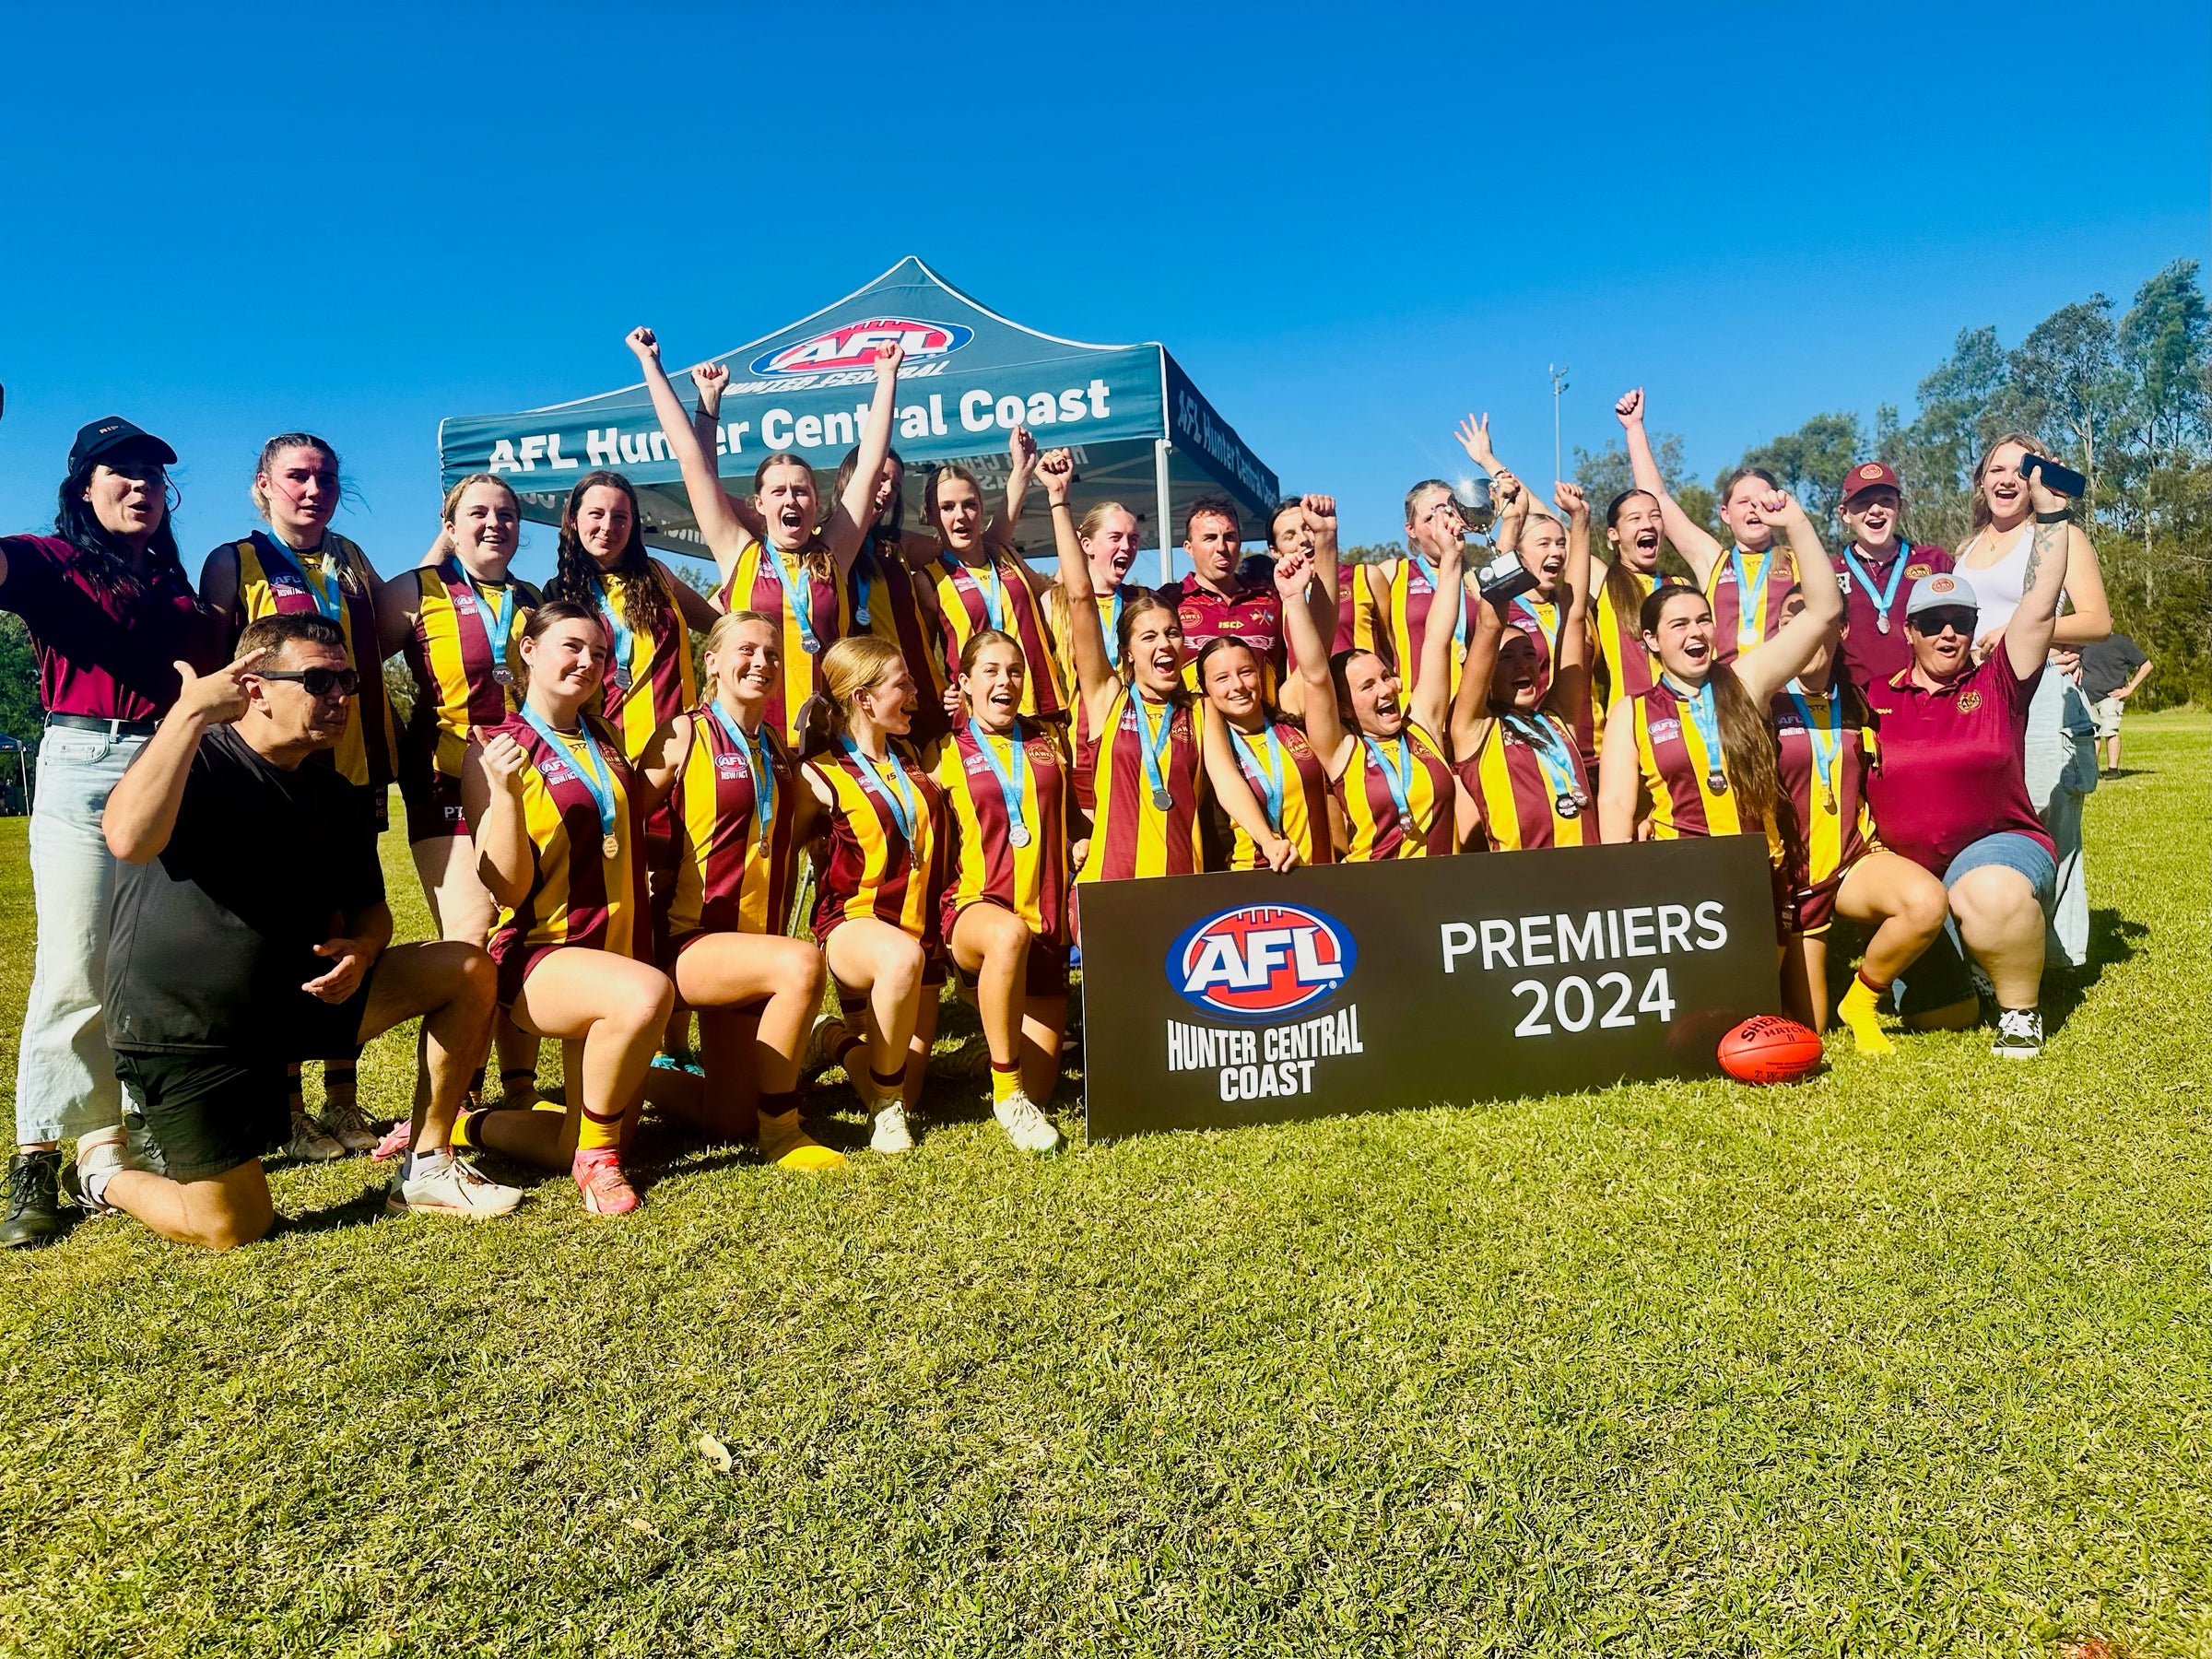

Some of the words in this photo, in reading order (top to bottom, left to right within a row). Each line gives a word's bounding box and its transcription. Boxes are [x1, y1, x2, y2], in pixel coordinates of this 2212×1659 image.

[762, 330, 948, 371] AFL
[819, 360, 950, 389] CENRAL
[488, 433, 579, 474] AFL
[959, 379, 1111, 432] Coast
[1652, 721, 1677, 733] AFL
[1778, 716, 1803, 724] AFL
[720, 756, 747, 767] AFL
[721, 770, 748, 781] NSW/ACT
[887, 772, 897, 782] IS
[1441, 900, 1729, 973] PREMIERS
[1183, 926, 1344, 993] AFL
[1511, 968, 1677, 1038] 2024
[1167, 1018, 1257, 1072] HUNTER
[1264, 1003, 1364, 1063] CENTRAL
[1764, 1026, 1807, 1038] MATCH
[1219, 1060, 1316, 1102] COAST
